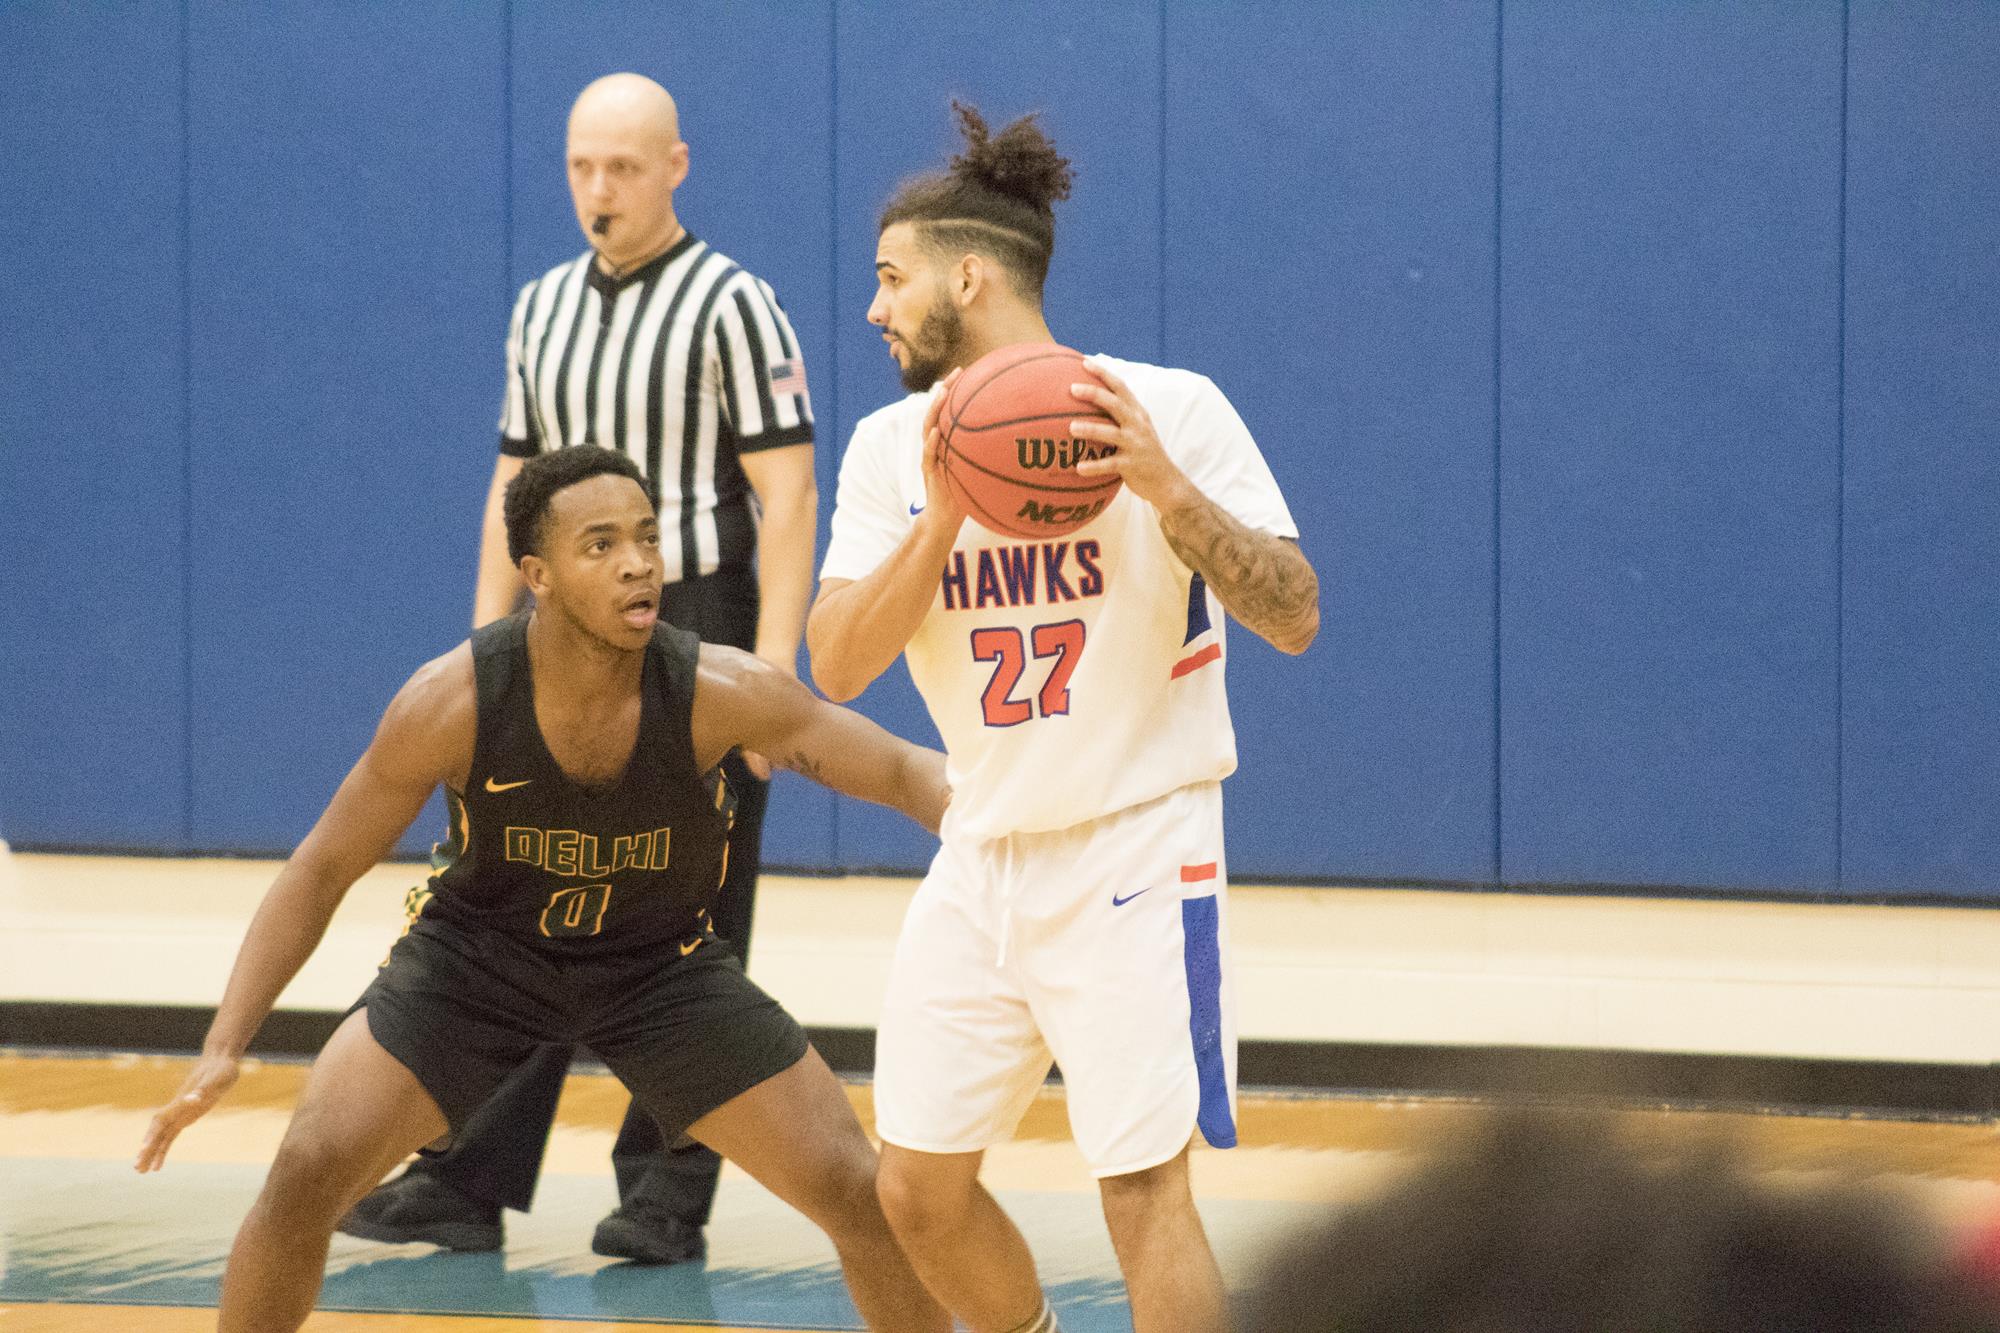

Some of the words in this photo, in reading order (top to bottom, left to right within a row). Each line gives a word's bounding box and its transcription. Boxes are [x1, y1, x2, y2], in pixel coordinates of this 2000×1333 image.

[942, 539, 1104, 611] HAWKS
[970, 618, 1086, 727] 22
[505, 827, 671, 878] DELHI
[539, 884, 612, 937] 0
